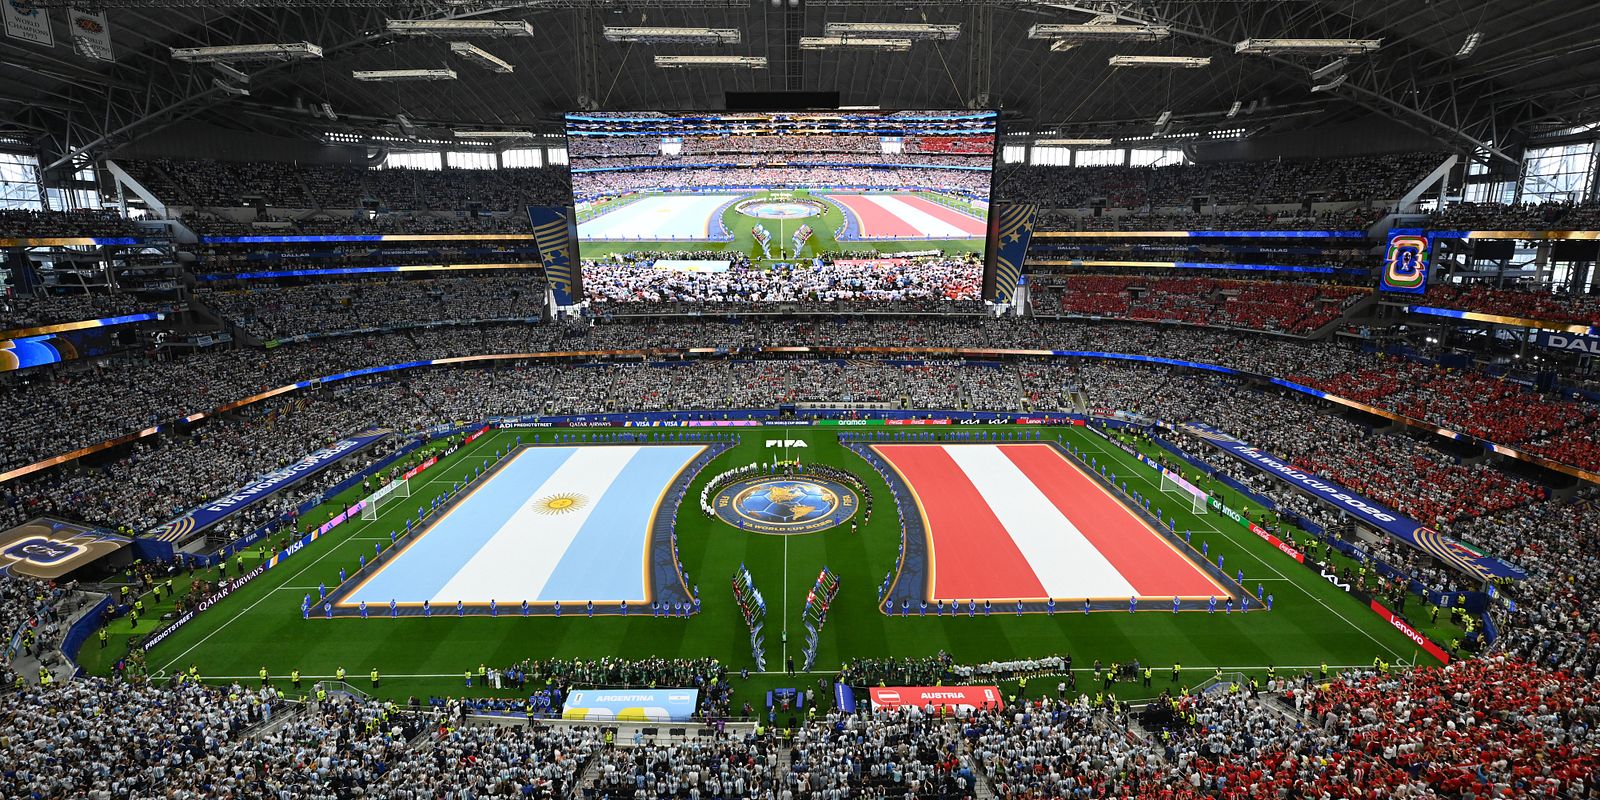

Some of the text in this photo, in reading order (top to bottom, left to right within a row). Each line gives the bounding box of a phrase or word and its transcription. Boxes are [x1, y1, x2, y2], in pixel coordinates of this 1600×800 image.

[1258, 458, 1307, 479] WORLD
[1303, 480, 1337, 493] CUP
[1330, 493, 1396, 522] 2026
[285, 540, 304, 556] VISA
[199, 565, 264, 611] QATAR AIRWAYS
[145, 611, 194, 650] PREDICTSTREET
[1390, 615, 1424, 645] Lenovo
